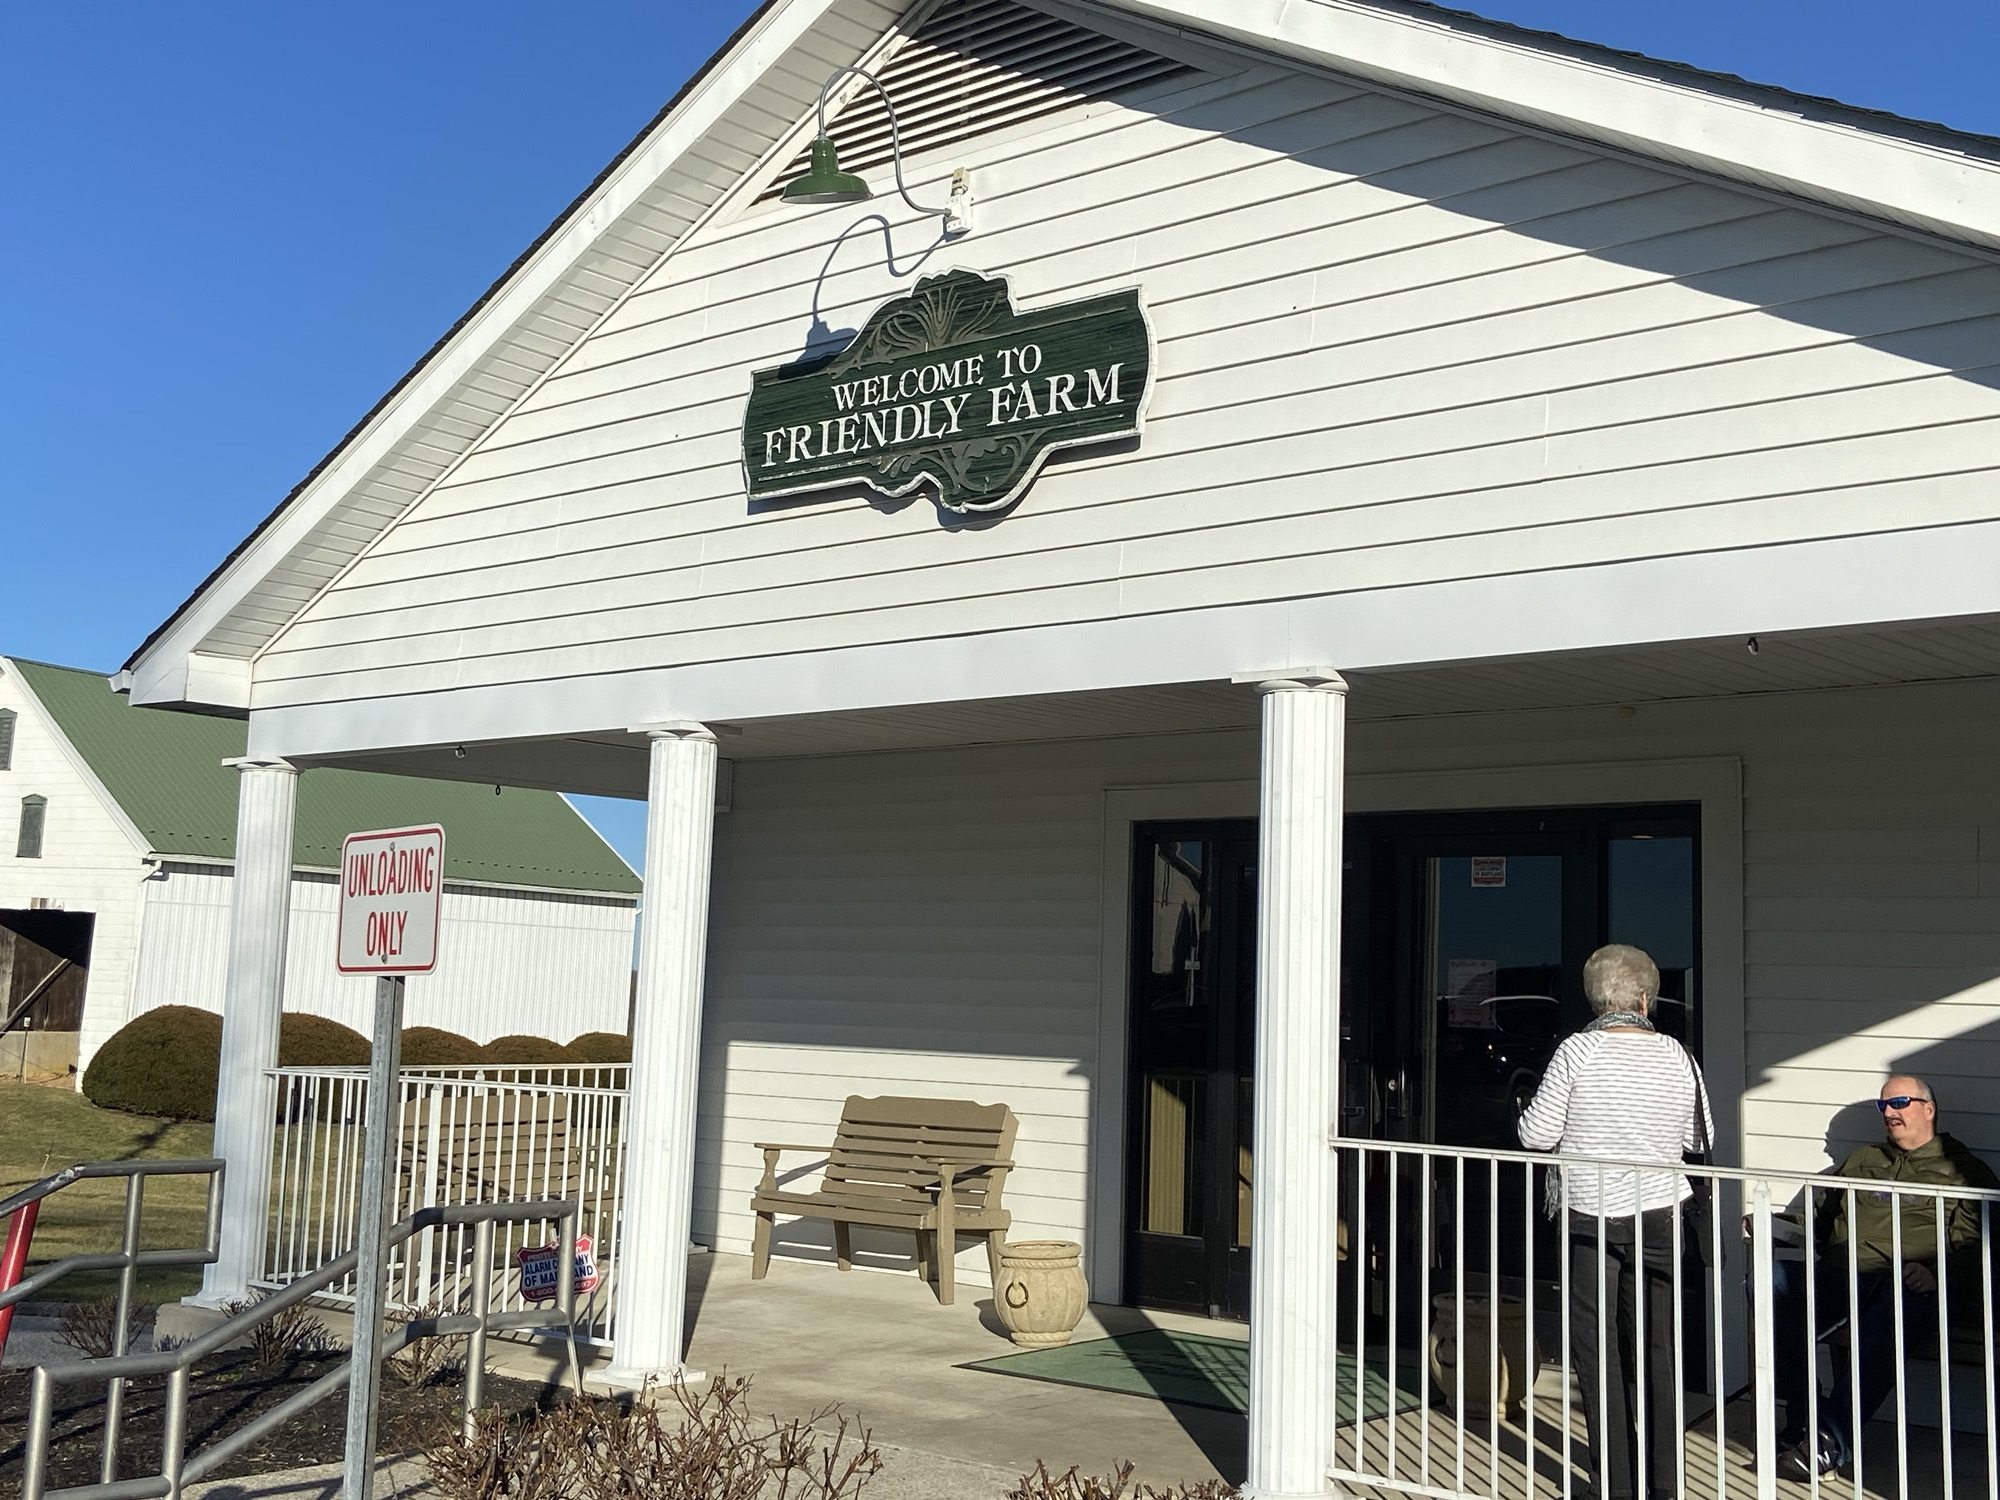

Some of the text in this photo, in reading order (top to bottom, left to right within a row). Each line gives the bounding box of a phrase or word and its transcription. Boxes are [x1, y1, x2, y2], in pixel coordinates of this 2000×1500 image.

[831, 345, 1041, 411] WELCOME TO
[761, 363, 1124, 467] FRIENDLY FARM
[348, 847, 434, 897] UNLOADING
[366, 911, 408, 957] ONLY
[524, 1265, 593, 1287] OF MAAND
[525, 1253, 589, 1275] ALARM CANY
